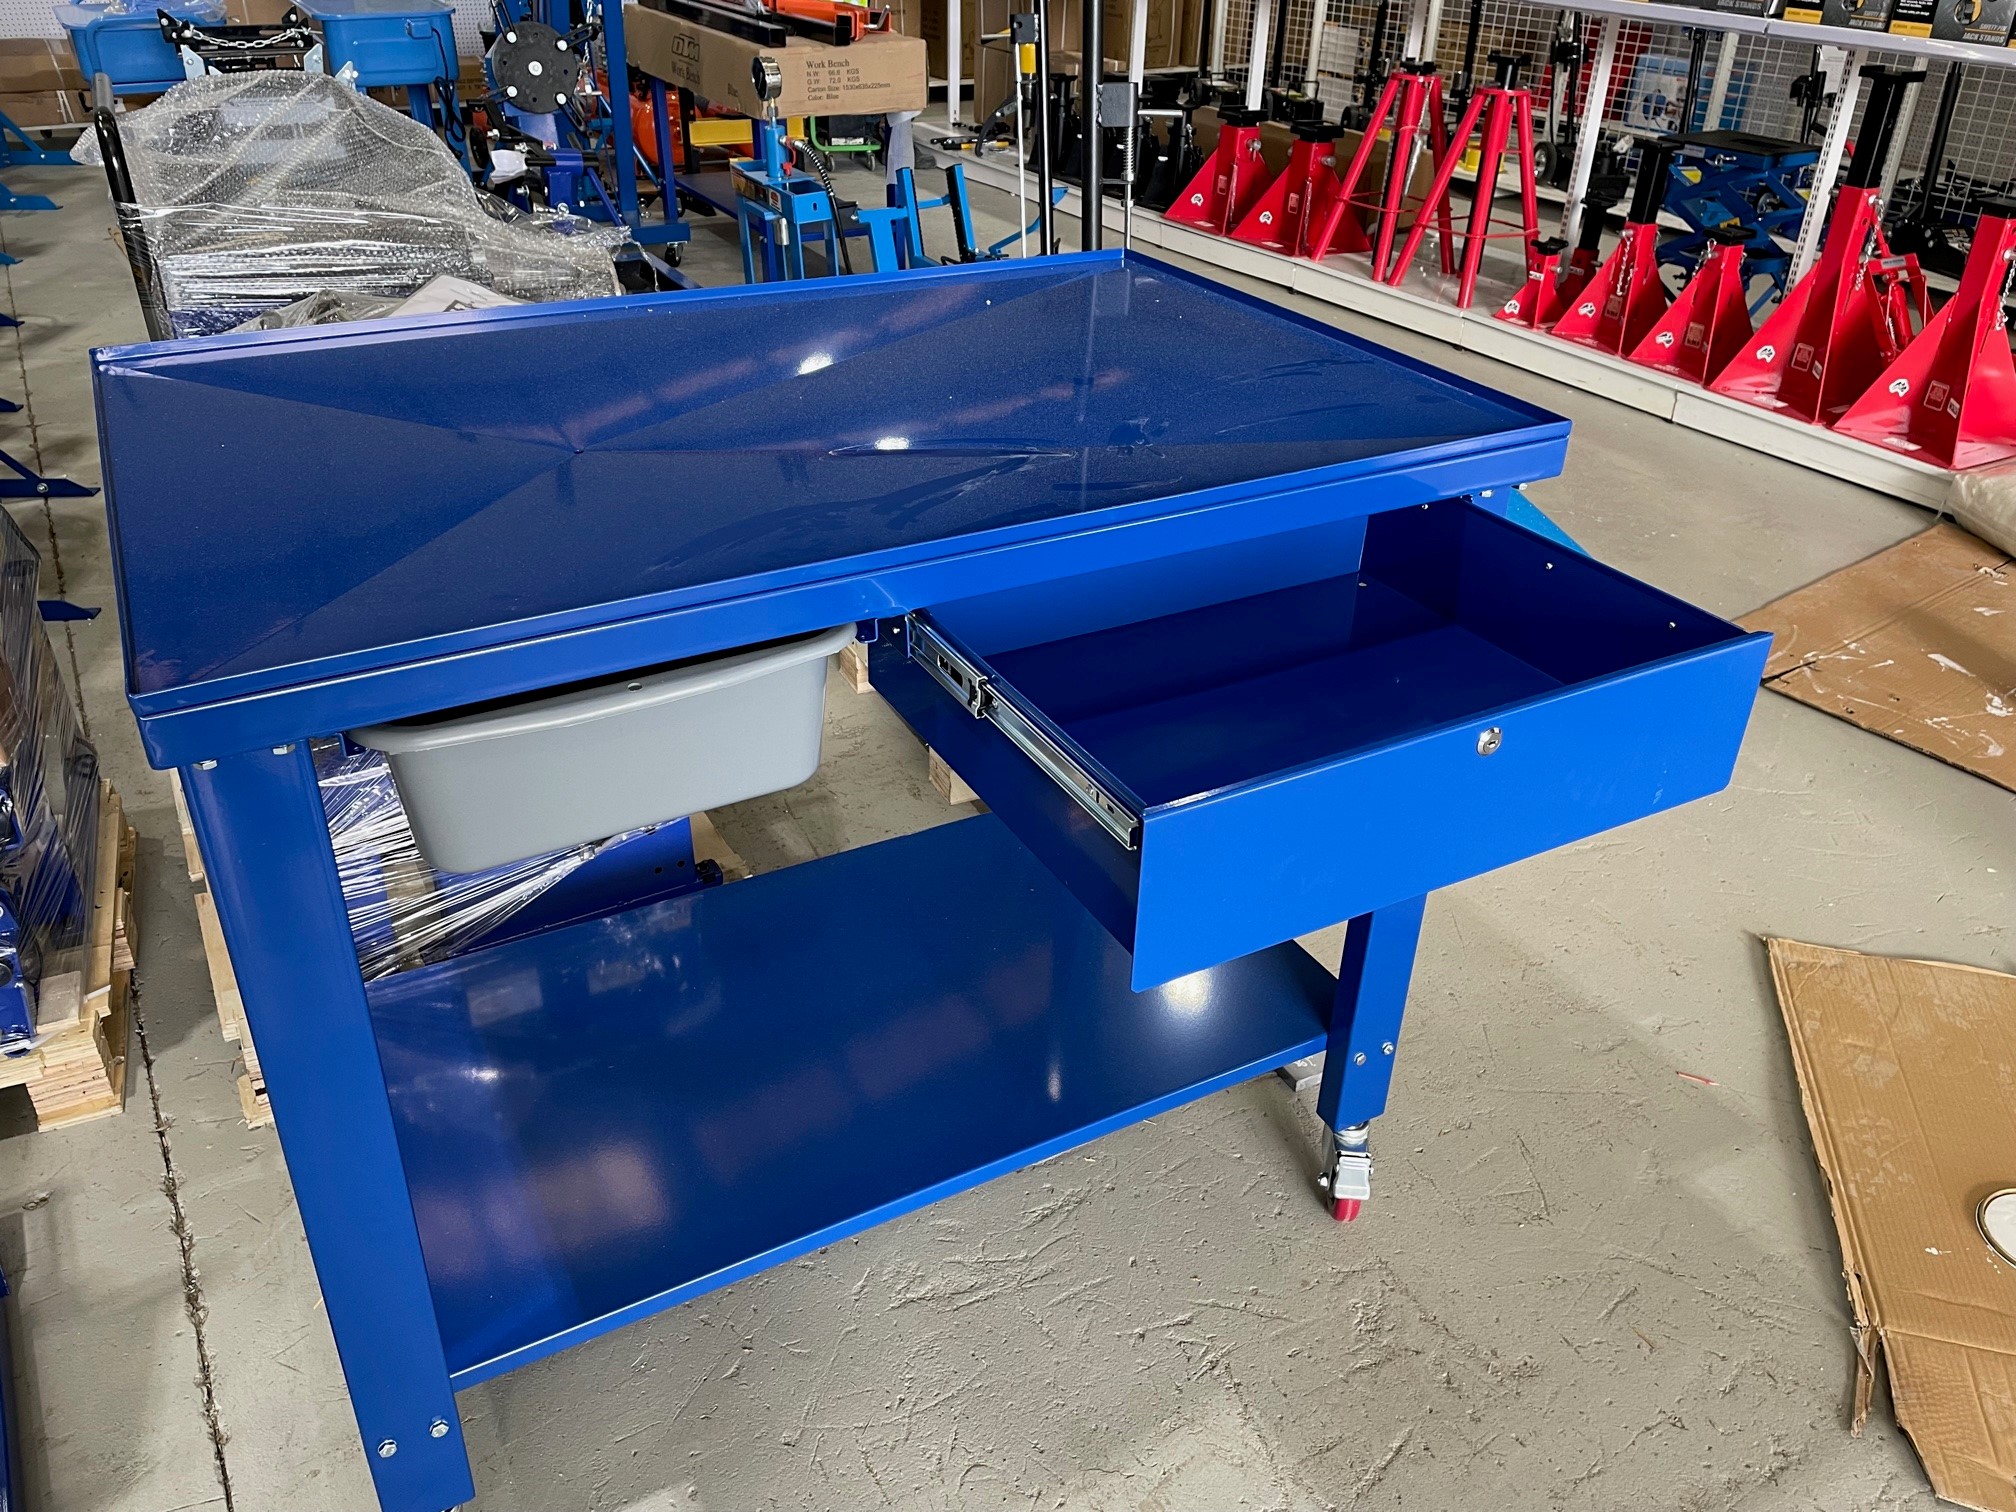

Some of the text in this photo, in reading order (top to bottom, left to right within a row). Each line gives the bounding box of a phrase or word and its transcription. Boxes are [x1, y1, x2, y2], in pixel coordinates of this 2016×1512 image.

[1962, 32, 2005, 43] JACK STANDS
[806, 58, 850, 69] Work Bench
